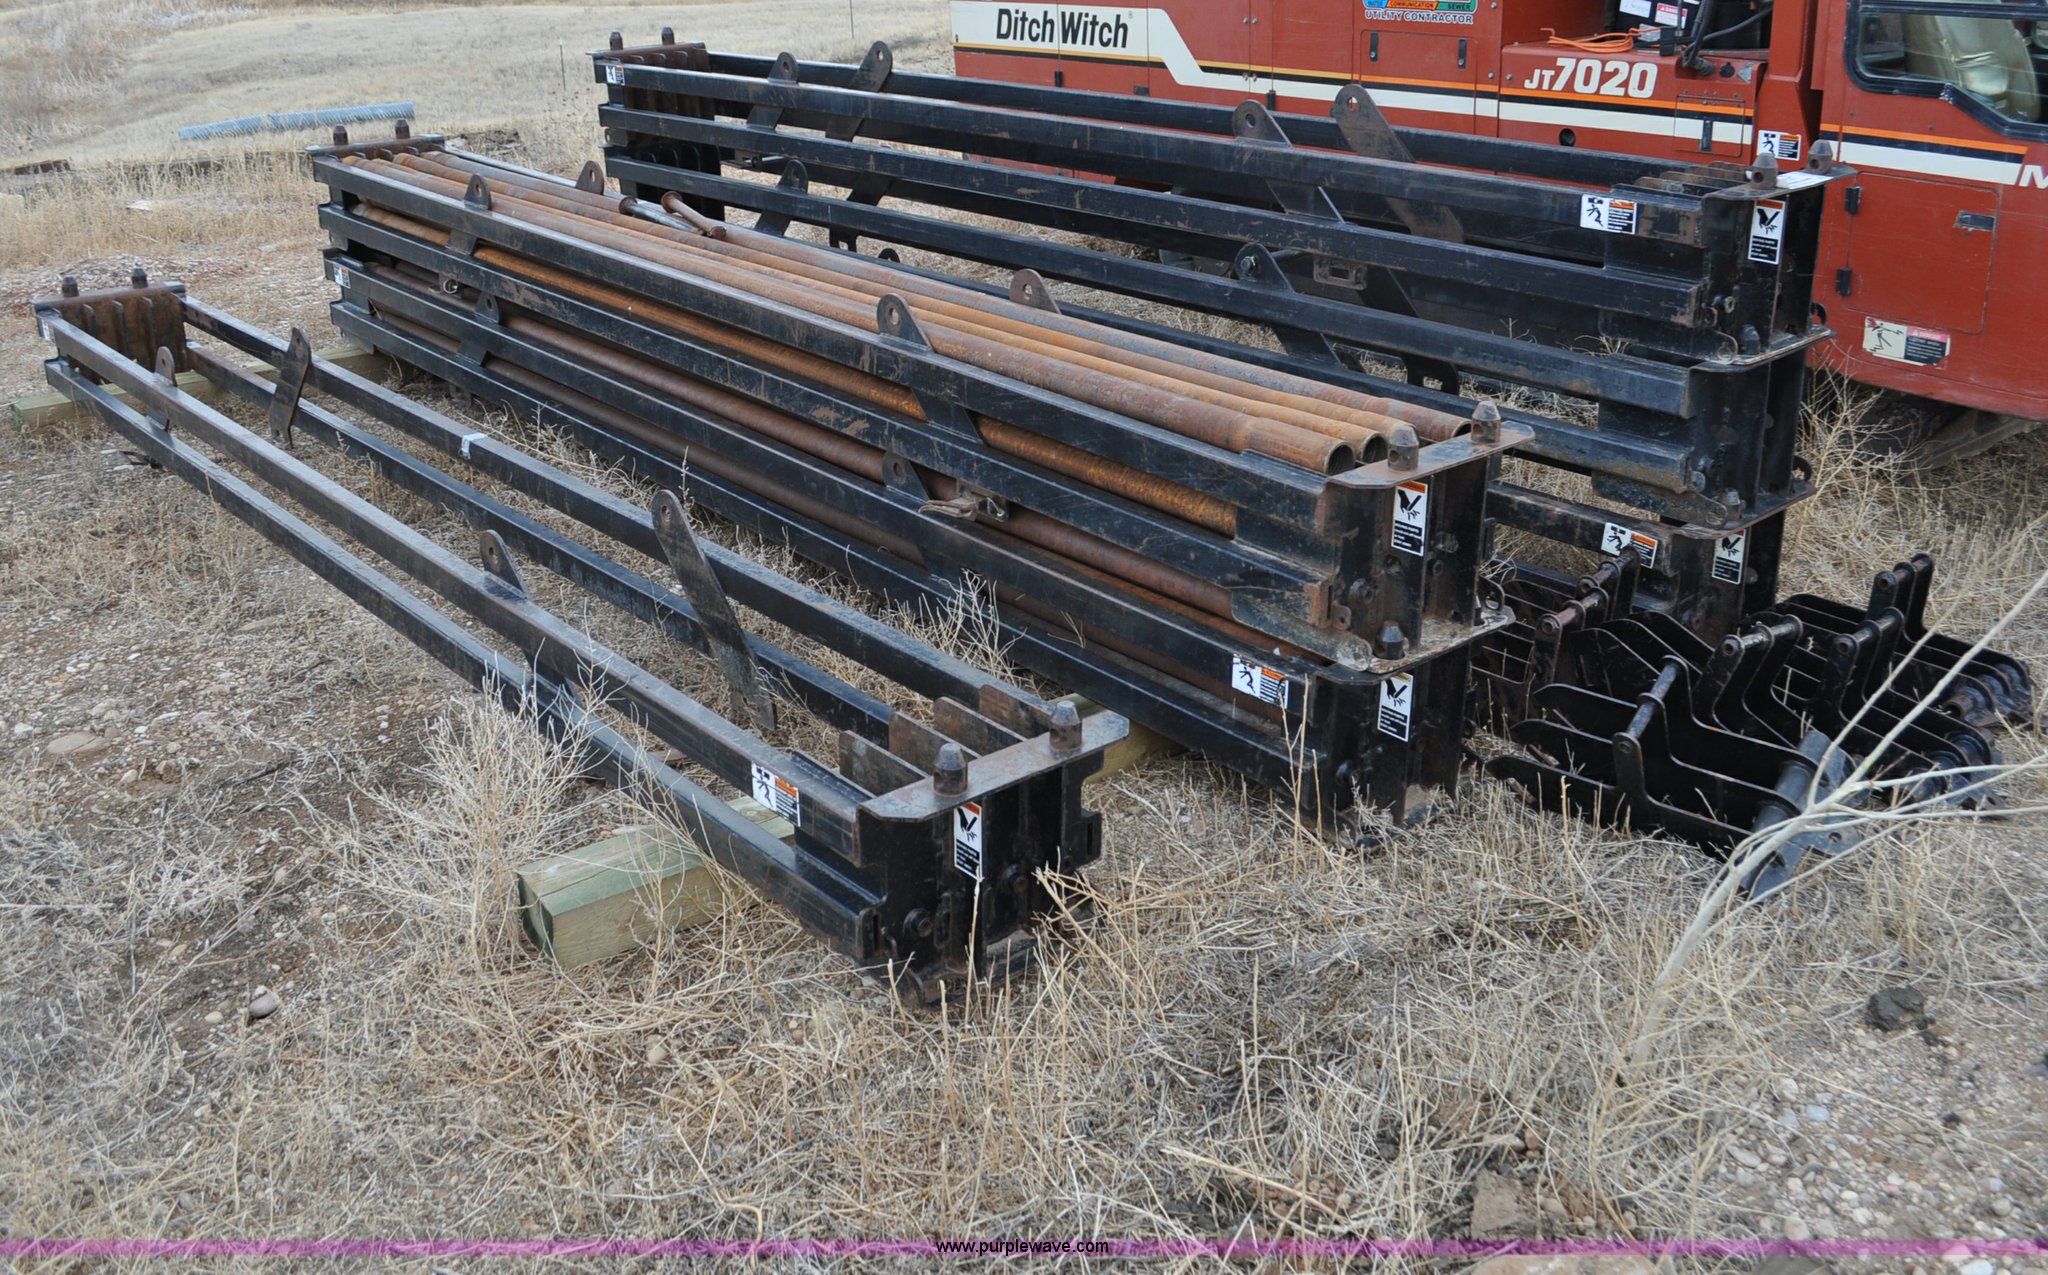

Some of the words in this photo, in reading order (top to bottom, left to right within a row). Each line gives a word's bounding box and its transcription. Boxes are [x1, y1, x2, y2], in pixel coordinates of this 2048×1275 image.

[996, 8, 1055, 43] Ditch
[1060, 11, 1128, 48] Witch
[1364, 10, 1403, 20] UTILITY
[1404, 11, 1473, 24] CONTRACTOR
[1524, 57, 1658, 98] JT7020
